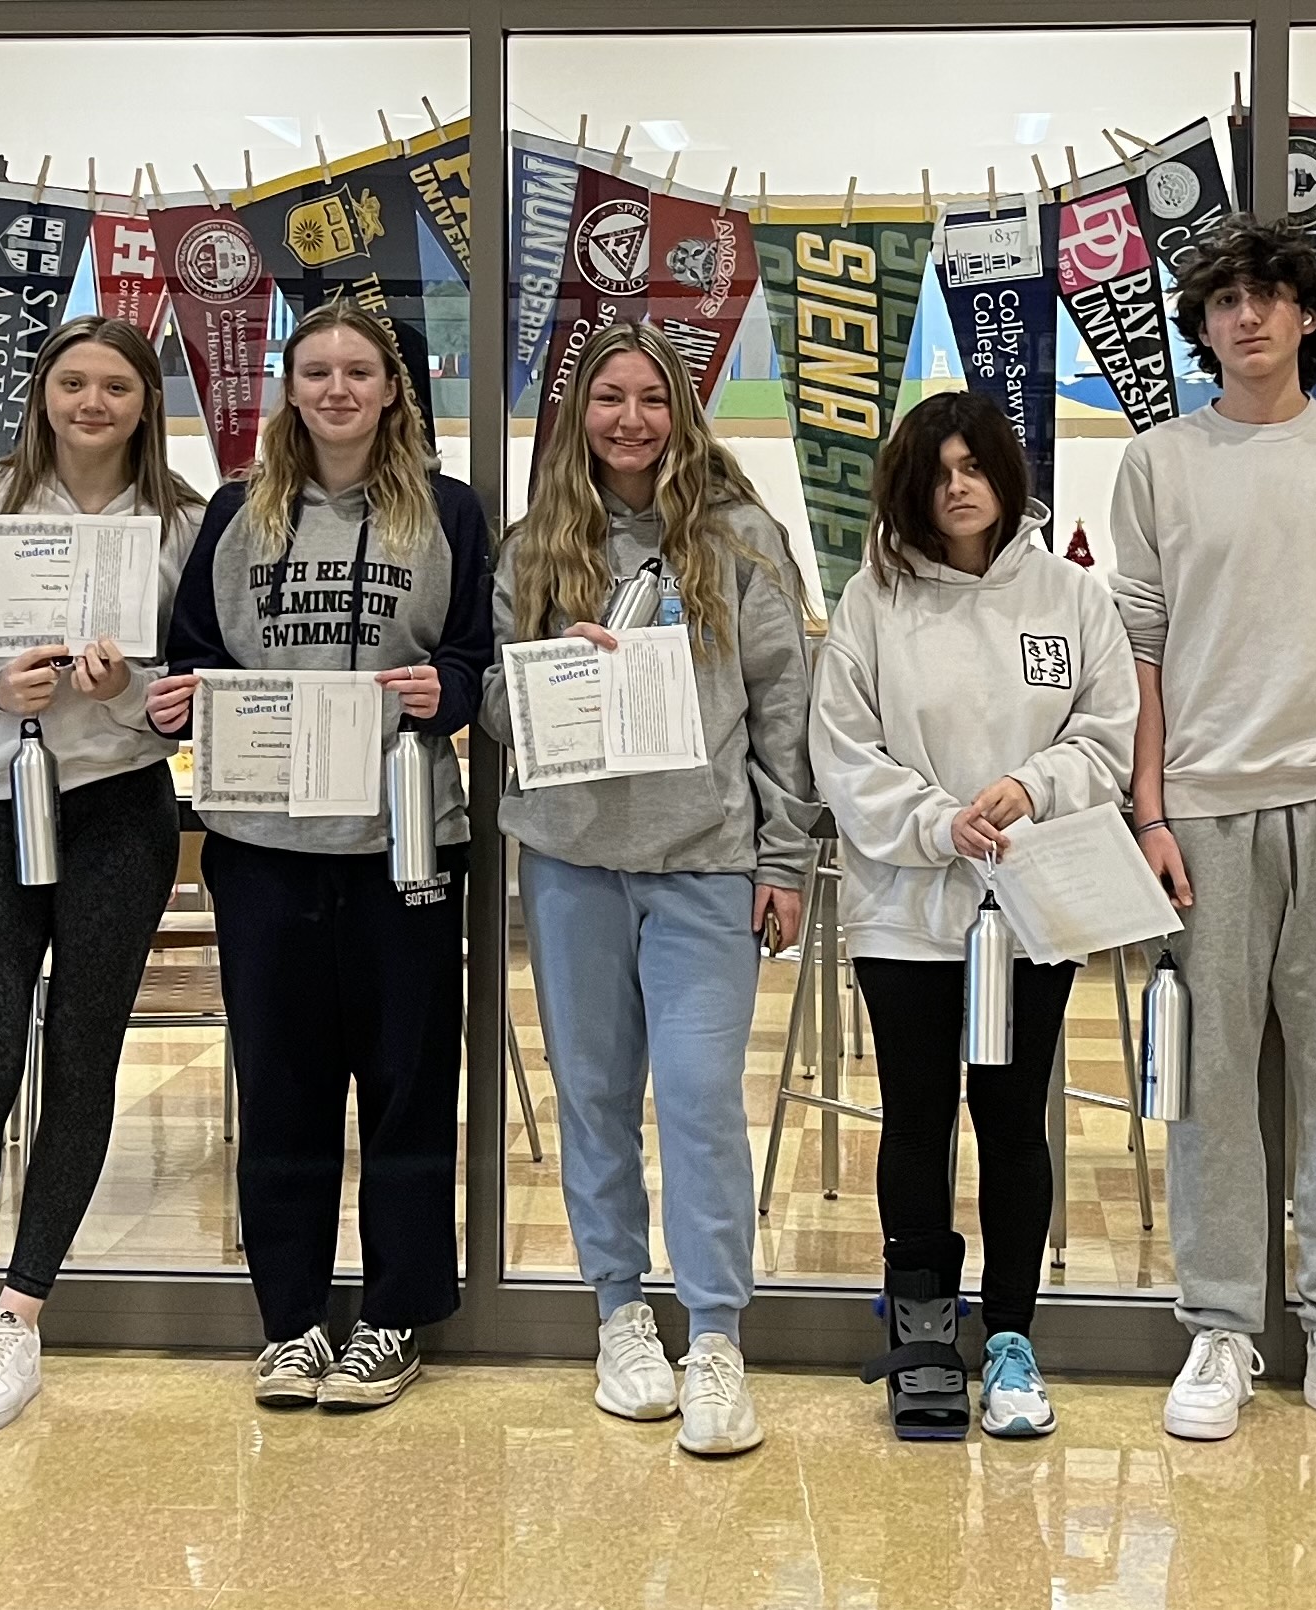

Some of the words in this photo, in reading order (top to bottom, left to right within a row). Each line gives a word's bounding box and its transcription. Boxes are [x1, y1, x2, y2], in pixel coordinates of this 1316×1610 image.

[988, 227, 1021, 246] 1837
[700, 218, 737, 319] AMCATS
[1058, 253, 1078, 287] 1897
[1108, 267, 1161, 344] BAY
[207, 330, 222, 378] HEALTH
[220, 309, 233, 363] COLLEGE
[234, 309, 252, 402] MASSACHUSETTS
[548, 318, 591, 406] COLLEGE
[795, 230, 881, 441] SIENA
[972, 293, 995, 379] College
[3, 285, 58, 441] SAINT
[1134, 350, 1175, 423] PAT
[211, 378, 225, 433] SCIENCES
[225, 376, 241, 437] PHARMACY
[14, 547, 55, 560] Student
[57, 546, 70, 556] of
[256, 590, 399, 620] WLMINGTON
[262, 621, 381, 649] SWIMMING
[548, 668, 590, 686] Student
[235, 704, 277, 717] Student
[279, 702, 291, 713] of
[405, 887, 447, 907] SOFTBALL
